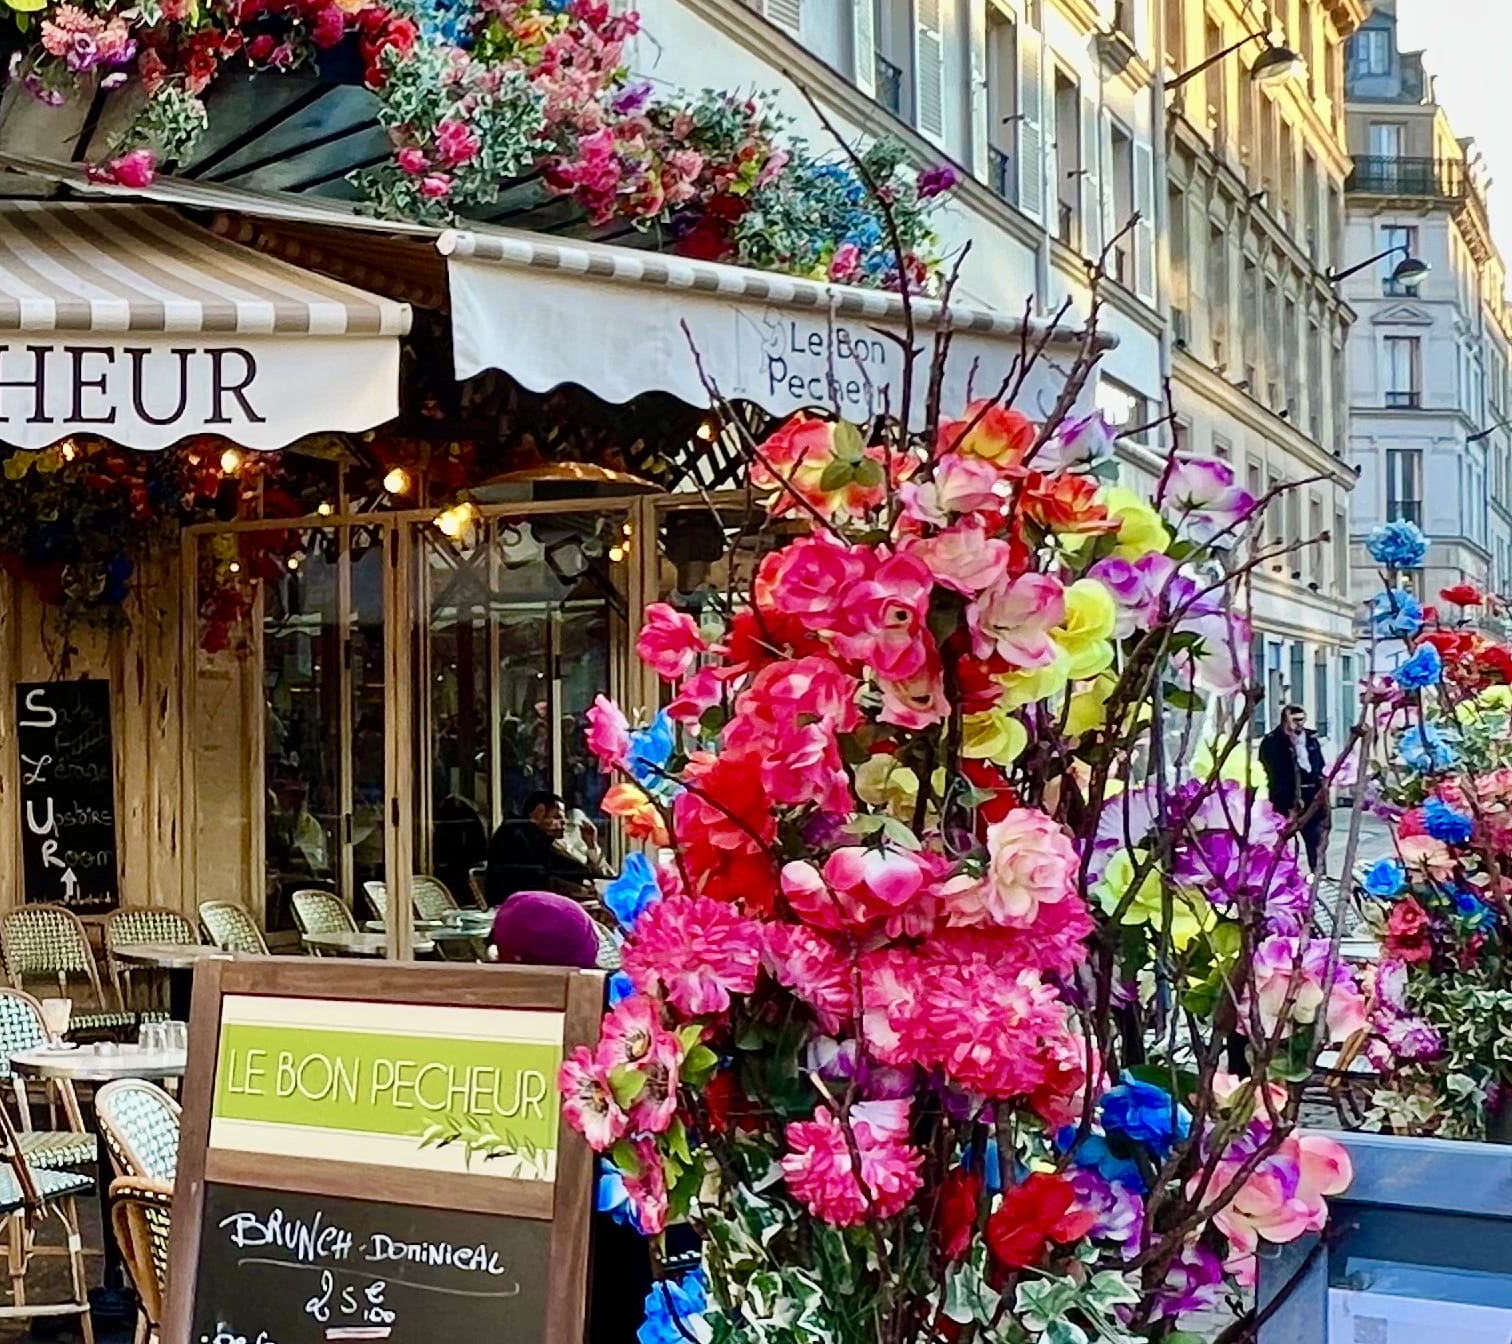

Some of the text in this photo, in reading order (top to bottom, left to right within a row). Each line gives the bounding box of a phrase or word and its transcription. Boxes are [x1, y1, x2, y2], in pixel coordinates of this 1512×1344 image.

[790, 321, 886, 365] Le Bon
[767, 353, 887, 409] Pecher
[228, 1048, 547, 1119] LE BON PECHEUR
[219, 1208, 353, 1261] BRUNCH
